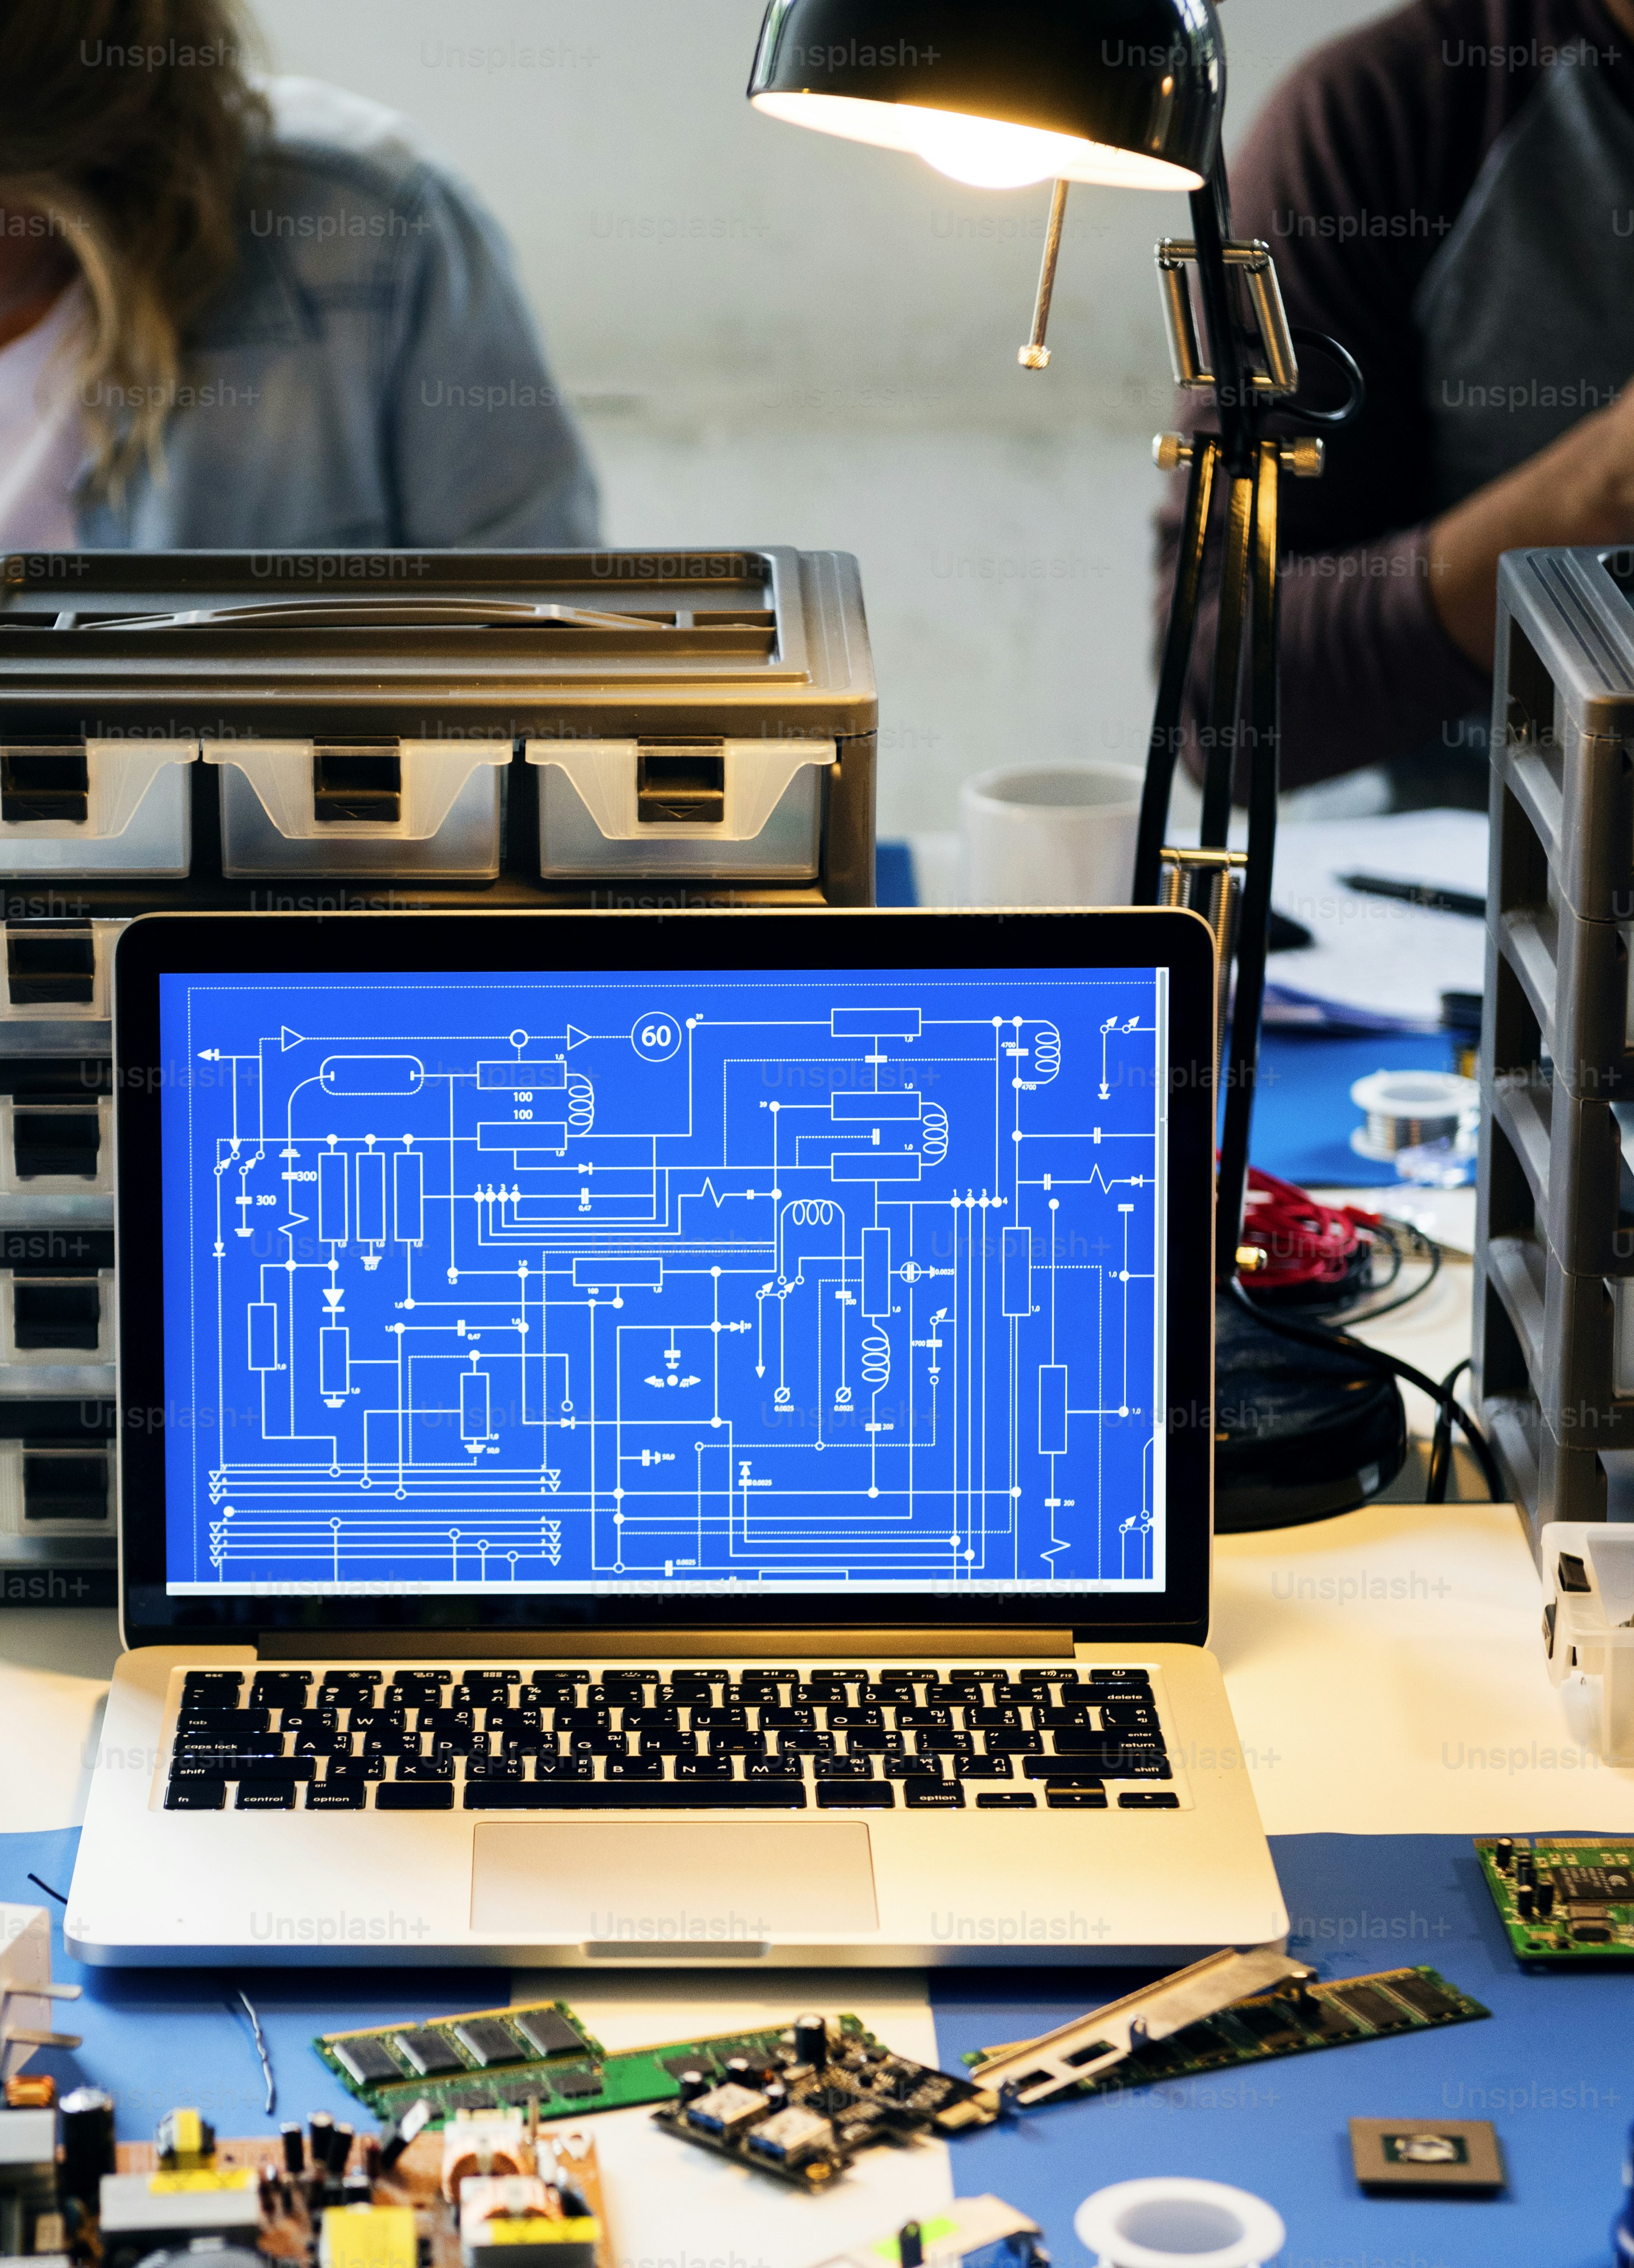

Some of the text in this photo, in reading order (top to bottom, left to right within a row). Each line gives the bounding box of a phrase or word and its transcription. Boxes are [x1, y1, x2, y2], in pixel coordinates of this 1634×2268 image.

[641, 1025, 671, 1047] 60
[513, 1092, 532, 1102] 100
[513, 1109, 532, 1120] 100
[297, 1171, 317, 1182] 300
[477, 1184, 518, 1192] 1 2 3 4
[953, 1189, 957, 1197] 1
[967, 1189, 972, 1197] 2
[981, 1189, 987, 1197] 3
[256, 1195, 276, 1206] 300
